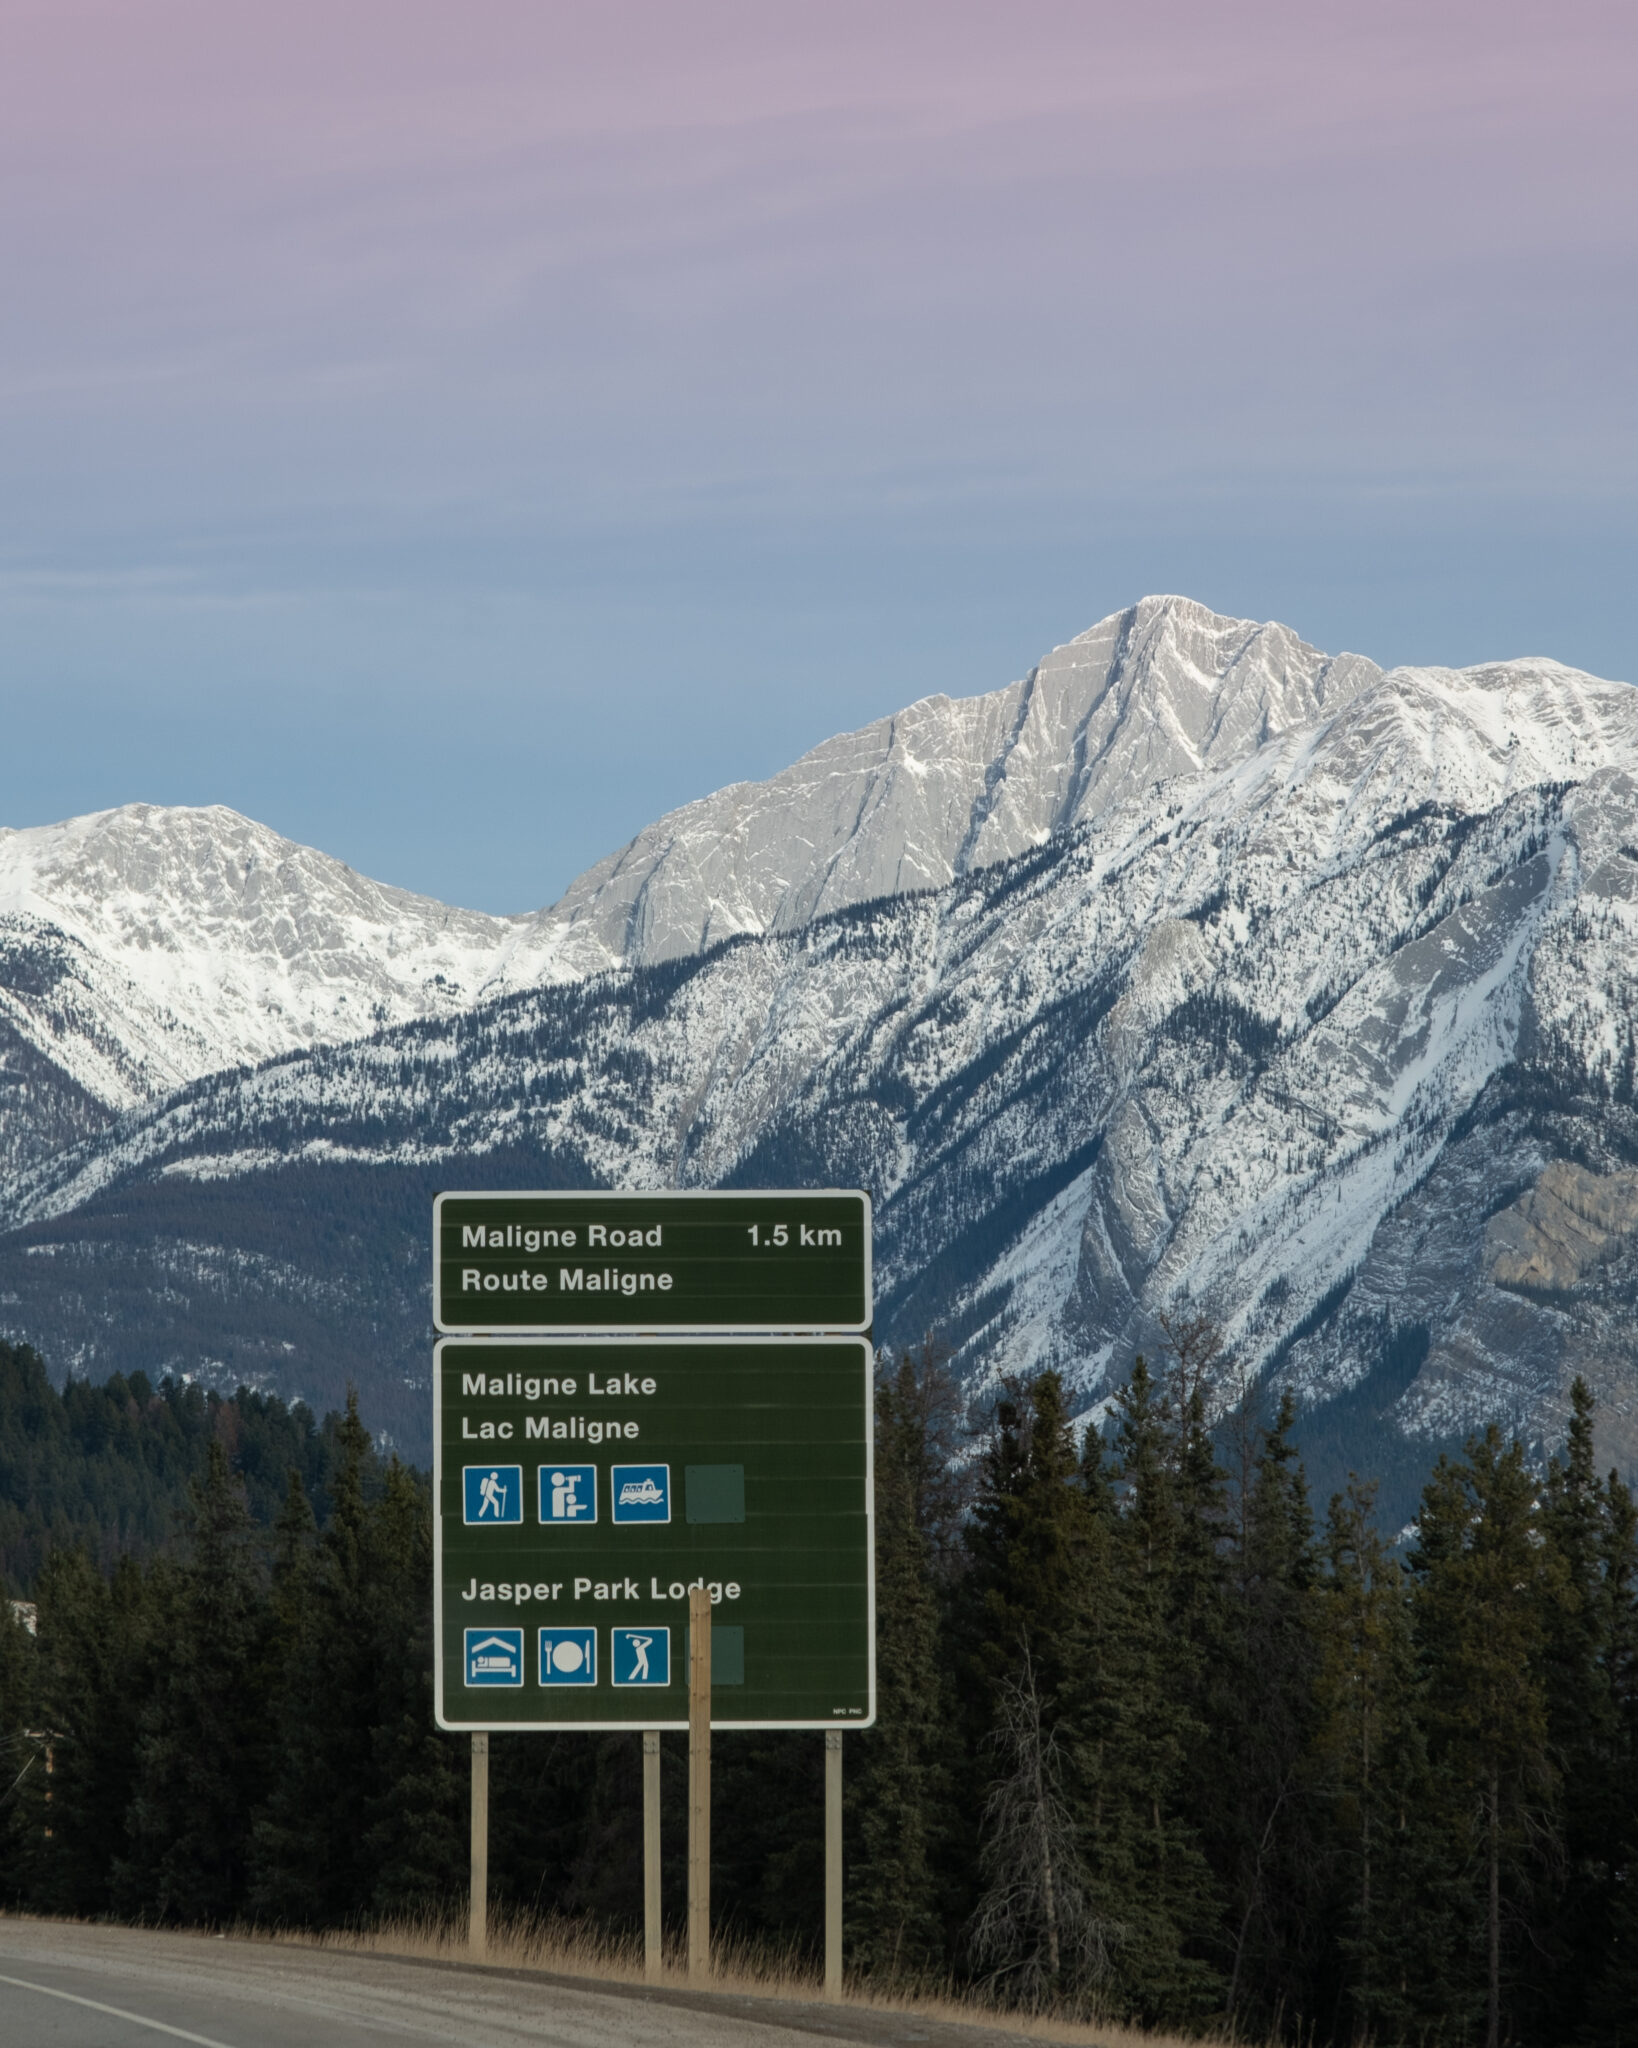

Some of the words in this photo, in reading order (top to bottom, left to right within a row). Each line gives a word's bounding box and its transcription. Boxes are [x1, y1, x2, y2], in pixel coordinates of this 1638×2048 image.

[463, 1225, 577, 1252] Maligne
[588, 1224, 662, 1247] Road
[748, 1224, 789, 1247] 1.5
[800, 1224, 842, 1246] km
[462, 1268, 548, 1291] Route
[560, 1269, 673, 1296] Maligne
[462, 1373, 577, 1400] Maligne
[588, 1373, 657, 1395] Lake
[462, 1417, 514, 1439] Lac
[525, 1416, 640, 1444] Maligne
[461, 1577, 563, 1605] Jasper
[574, 1577, 640, 1600] Park
